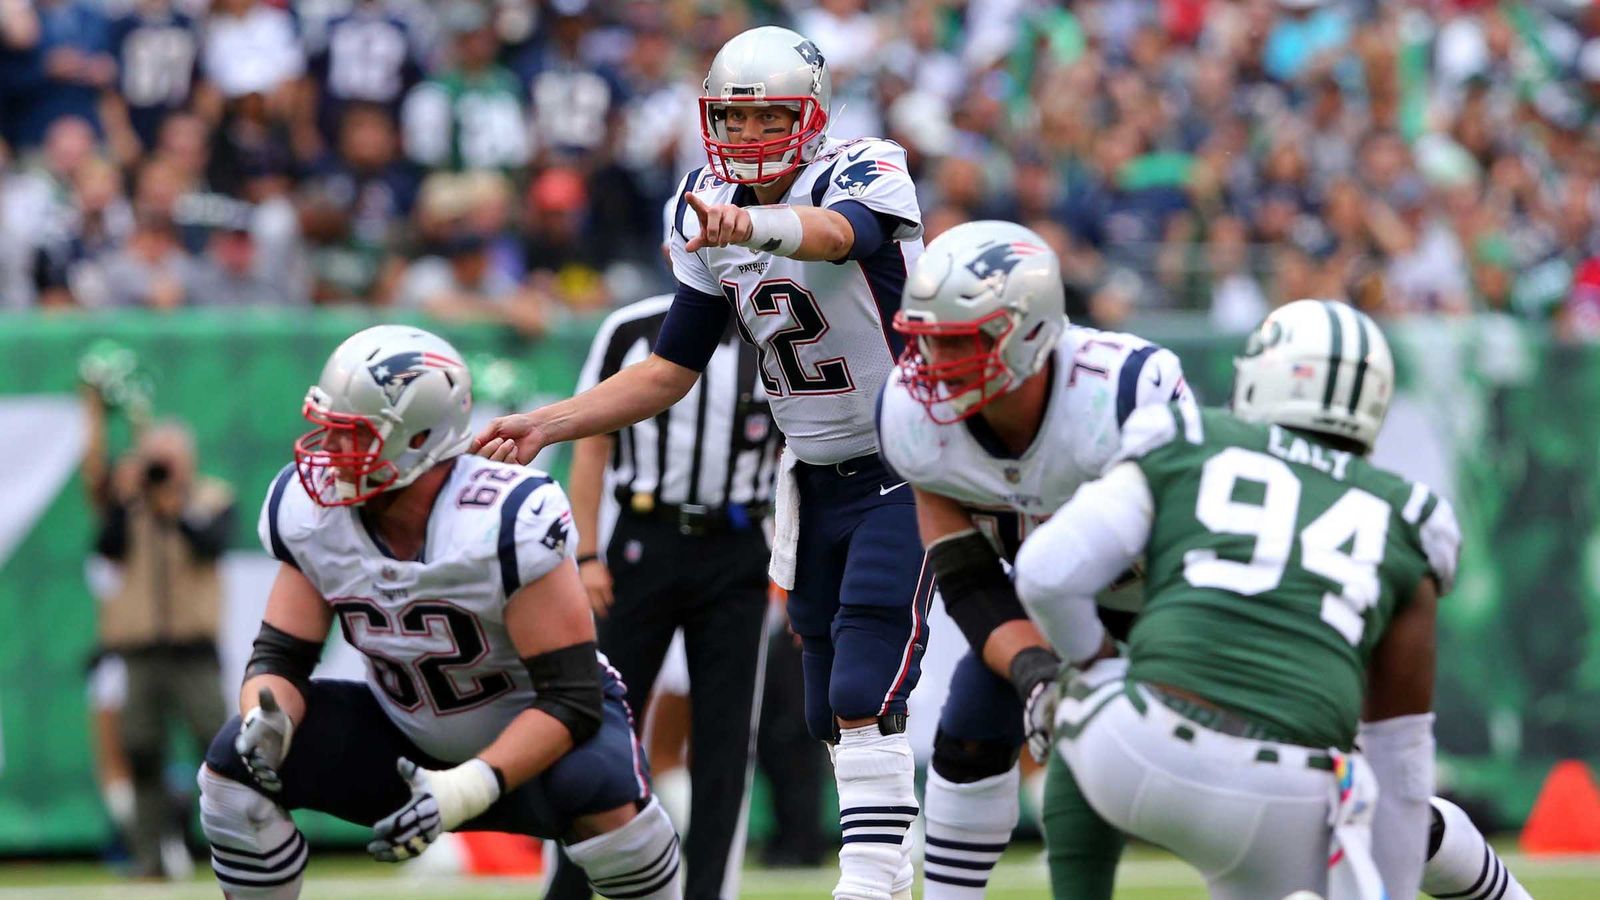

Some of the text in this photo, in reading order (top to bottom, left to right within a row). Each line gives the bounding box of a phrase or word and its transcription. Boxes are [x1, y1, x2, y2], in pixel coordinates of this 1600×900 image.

[719, 279, 856, 397] 12
[455, 466, 520, 511] 62
[1183, 446, 1391, 648] 94
[329, 597, 516, 716] 62
